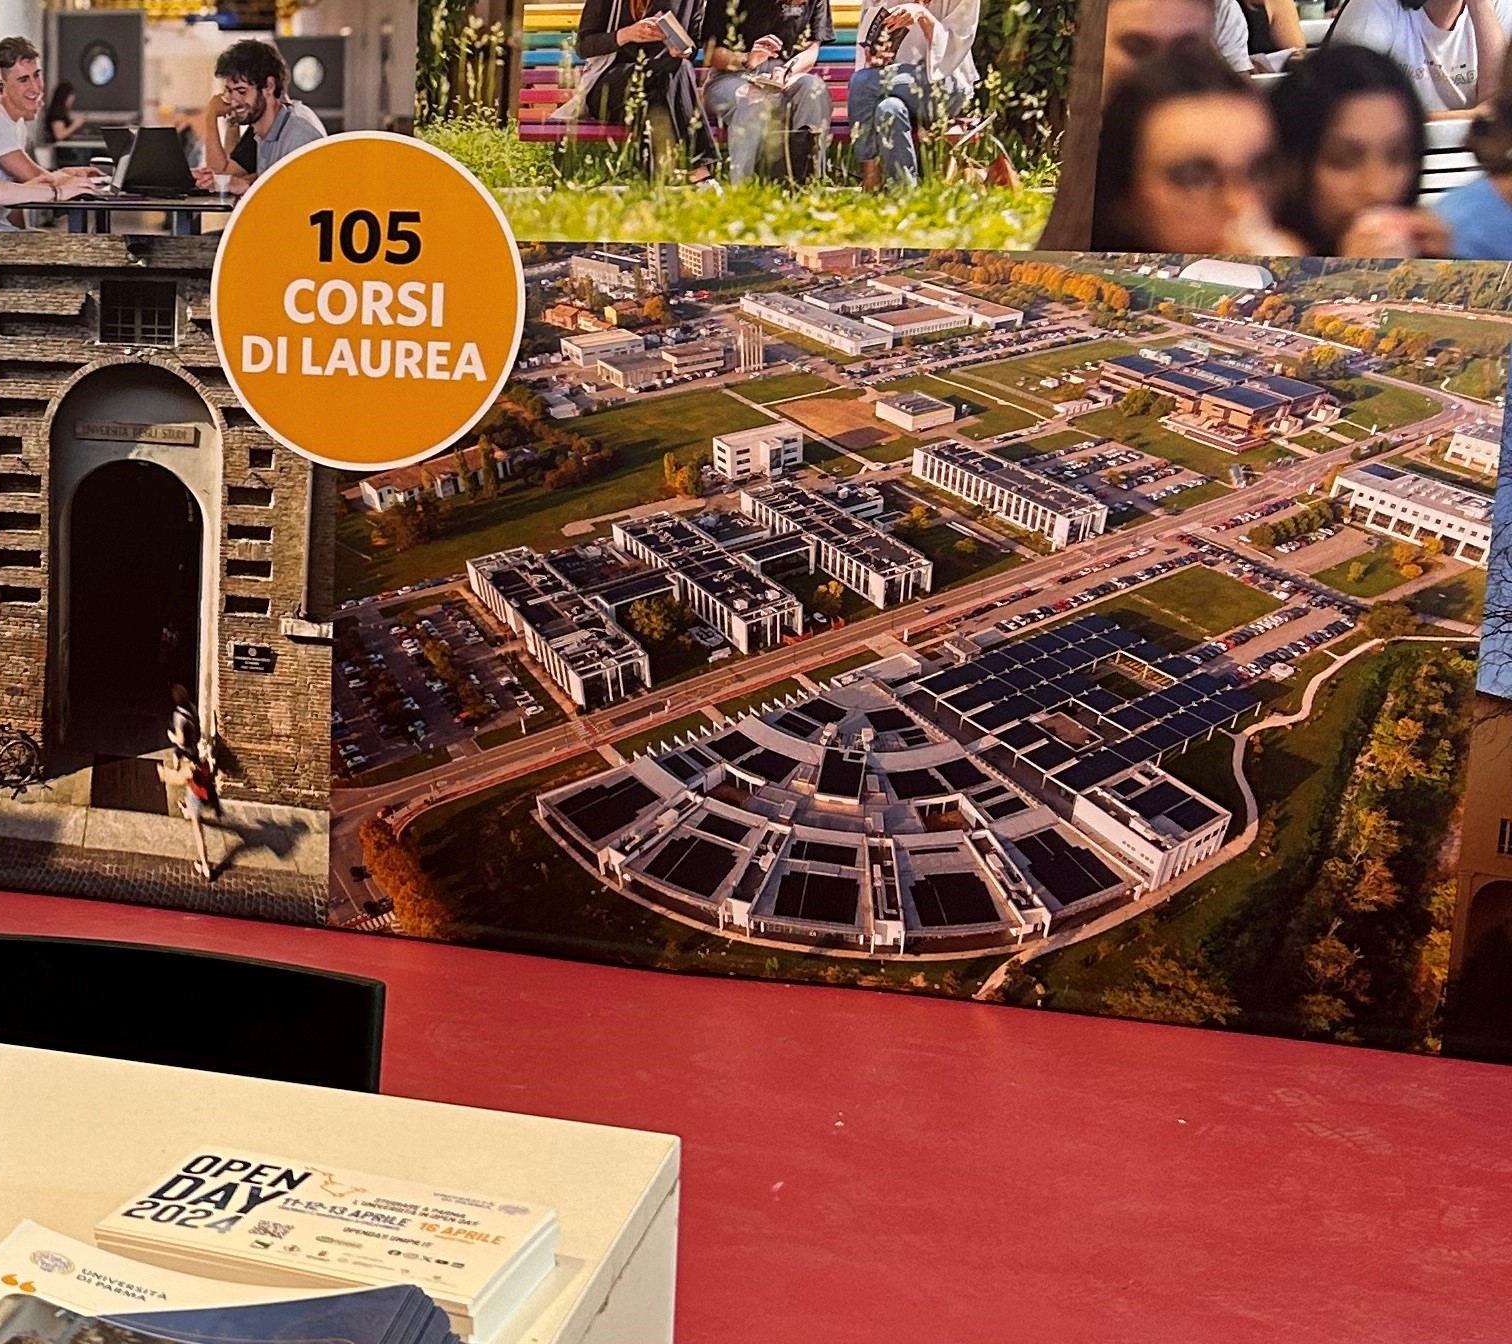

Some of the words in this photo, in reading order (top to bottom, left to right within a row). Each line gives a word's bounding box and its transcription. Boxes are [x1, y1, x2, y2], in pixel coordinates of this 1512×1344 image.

[309, 209, 422, 265] 105
[283, 278, 445, 328] CORSI
[241, 335, 288, 374] DI
[301, 336, 487, 381] LAUREA
[181, 1154, 313, 1190] OPEN
[147, 1174, 290, 1215] DAY
[121, 1200, 244, 1234] 2024
[348, 1208, 413, 1227] APRILE
[419, 1222, 441, 1233] 16
[440, 1225, 506, 1246] APRILE
[76, 1273, 93, 1285] DI
[95, 1281, 147, 1302] PARMA
